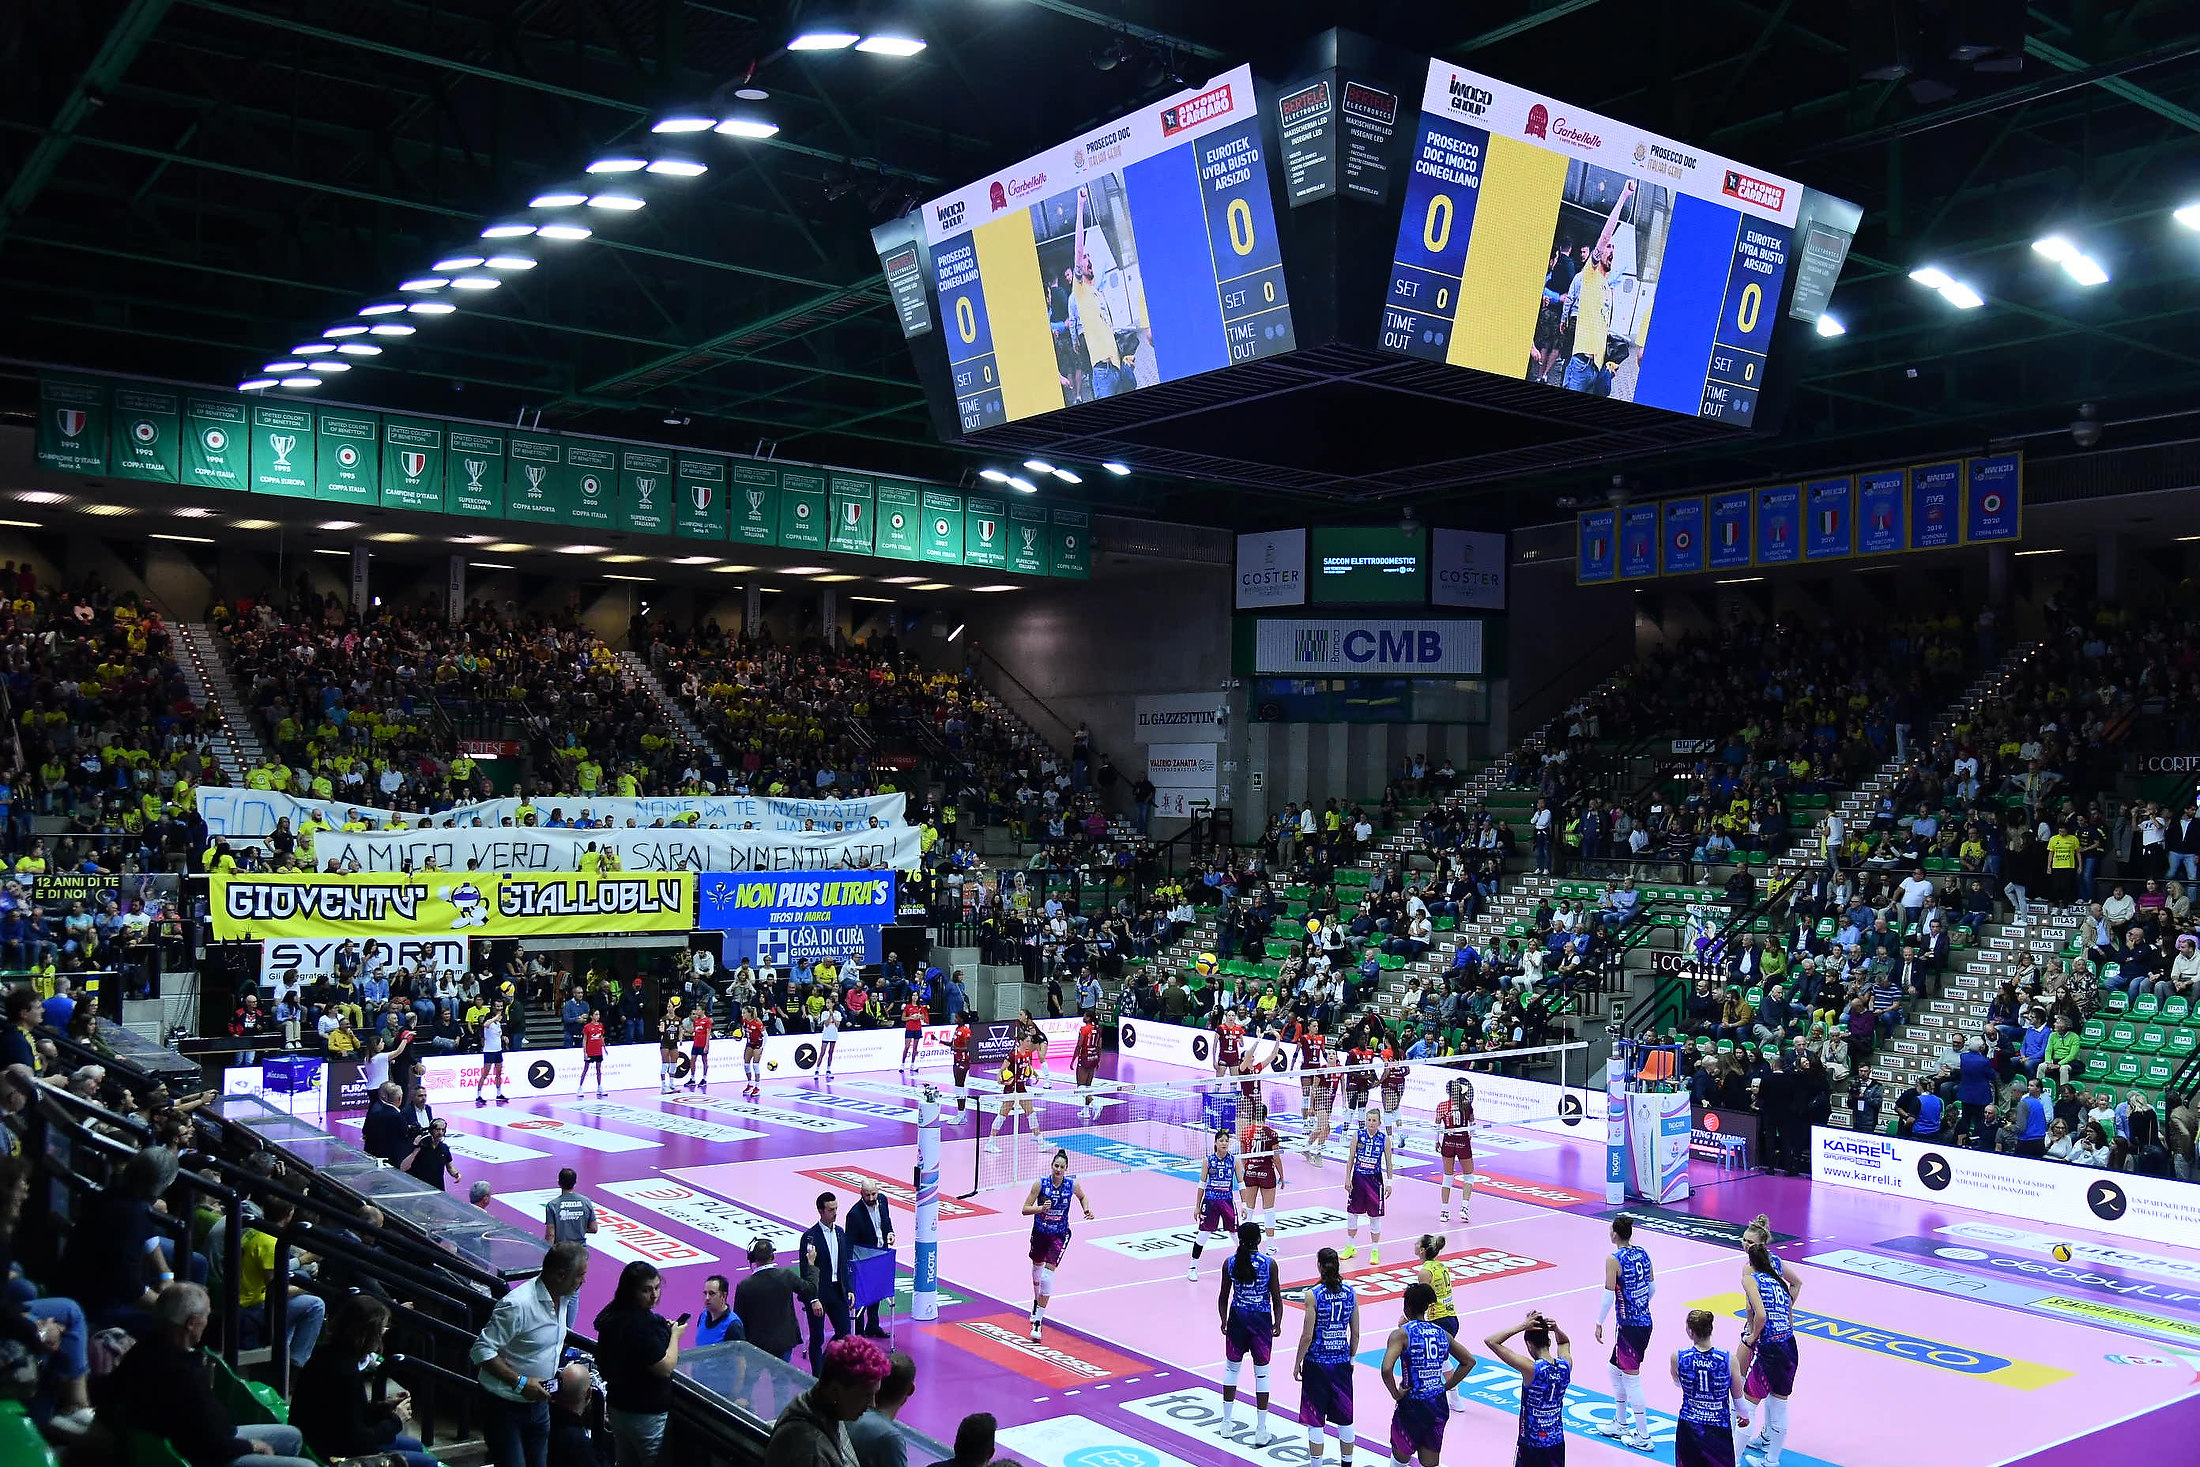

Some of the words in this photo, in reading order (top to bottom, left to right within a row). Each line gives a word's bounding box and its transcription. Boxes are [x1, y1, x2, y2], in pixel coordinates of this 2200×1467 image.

[1179, 89, 1227, 116] ANTONIO
[1179, 97, 1229, 128] CARRARO
[1285, 101, 1328, 122] ELECTRONICS
[1346, 101, 1391, 120] ELECTRONICS
[1345, 116, 1381, 133] MAXISCHERMI
[1381, 126, 1393, 136] LED
[1086, 134, 1118, 155] PROSECCO
[1118, 127, 1131, 145] DOC
[1373, 134, 1384, 143] LED
[1426, 131, 1479, 158] PROSECCO
[1206, 136, 1250, 164] EUROTEK
[1423, 146, 1445, 163] DOC
[1445, 153, 1477, 173] IMOCO
[1650, 144, 1684, 166] PROSECCO
[1684, 155, 1697, 170] DOC
[1202, 161, 1228, 181] UYBA
[1228, 149, 1259, 171] BUSTO
[1415, 160, 1479, 189] CONEGLIANO
[1215, 169, 1250, 191] ARSIZIO
[1739, 178, 1782, 197] ANTONIO
[1738, 186, 1781, 209] CARRARO
[1226, 198, 1254, 256] 0
[1423, 194, 1454, 253] 0
[1746, 230, 1782, 251] EUROTEK
[937, 246, 971, 268] PROSECCO
[1739, 241, 1759, 258] UYBA
[1759, 247, 1784, 265] BUSTO
[940, 265, 954, 279] DOC
[954, 258, 974, 277] IMOCO
[1743, 258, 1773, 275] ARSIZIO
[939, 269, 979, 292] CONEGLIANO
[1225, 290, 1246, 309] SET
[1263, 281, 1275, 302] 0
[1395, 279, 1420, 298] SET
[1437, 288, 1448, 309] 0
[1737, 283, 1762, 333] 0
[956, 296, 976, 344] 0
[1386, 312, 1416, 333] TIME
[1227, 322, 1256, 343] TIME
[1384, 332, 1412, 350] OUT
[1233, 341, 1256, 360] OUT
[957, 372, 972, 387] SET
[983, 365, 992, 383] 0
[1713, 356, 1733, 372] SET
[1744, 363, 1754, 381] 0
[1706, 384, 1730, 402] TIME
[960, 398, 981, 415] TIME
[1703, 402, 1724, 417] OUT
[964, 414, 981, 429] OUT
[458, 497, 492, 506] SUPERCOPPA
[1323, 557, 1350, 566] SACCON
[1351, 557, 1416, 566] ELETTRODOMESTICI
[1242, 571, 1299, 586] COSTER
[1439, 568, 1499, 586] COSTER
[1331, 629, 1341, 664] Banco
[1343, 629, 1443, 664] CMB
[1139, 713, 1150, 726] IL
[1151, 710, 1217, 725] GAZZETTIN
[635, 800, 694, 818] NOME
[703, 800, 727, 817] DA
[733, 800, 756, 817] TE
[767, 800, 868, 818] INVENTATO
[630, 842, 711, 871] SARAI
[36, 878, 50, 887] 12
[53, 878, 84, 887] ANNI
[88, 877, 100, 887] DI
[104, 877, 120, 887] TE
[905, 868, 922, 882] 76
[35, 889, 44, 899] E
[48, 889, 60, 899] DI
[64, 889, 87, 899] NOI
[735, 881, 776, 909] NON
[776, 881, 820, 908] PLUS
[821, 880, 889, 908] ULTRA'S
[769, 912, 793, 923] TIFOSI
[794, 912, 803, 922] DI
[804, 911, 831, 922] MARCA
[2054, 917, 2075, 925] ITLAS
[791, 927, 820, 946] CASA
[822, 927, 833, 945] DI
[834, 926, 864, 945] CURA
[2043, 929, 2063, 937] ITLAS
[791, 948, 840, 956] GIOVANNI
[842, 946, 865, 955] XXIII
[1961, 1020, 1981, 1028] ITLAS
[1823, 1139, 1901, 1161] KARRELL
[1823, 1166, 1902, 1187] www.karrell.it
[1488, 1181, 1581, 1202] subito
[689, 1201, 796, 1239] PULSEE
[1617, 1211, 1689, 1231] MASTER
[1693, 1227, 1744, 1241] GROU
[1643, 1222, 1705, 1237] SPORT
[1635, 1262, 1644, 1281] 9
[1989, 1257, 2200, 1306] debbyLin
[1771, 1284, 1785, 1305] 18
[1331, 1301, 1343, 1321] 17
[978, 1321, 1113, 1378] FRECCIAROSSA
[1424, 1337, 1438, 1360] 16
[1549, 1382, 1556, 1401] 1
[1698, 1370, 1709, 1392] 11
